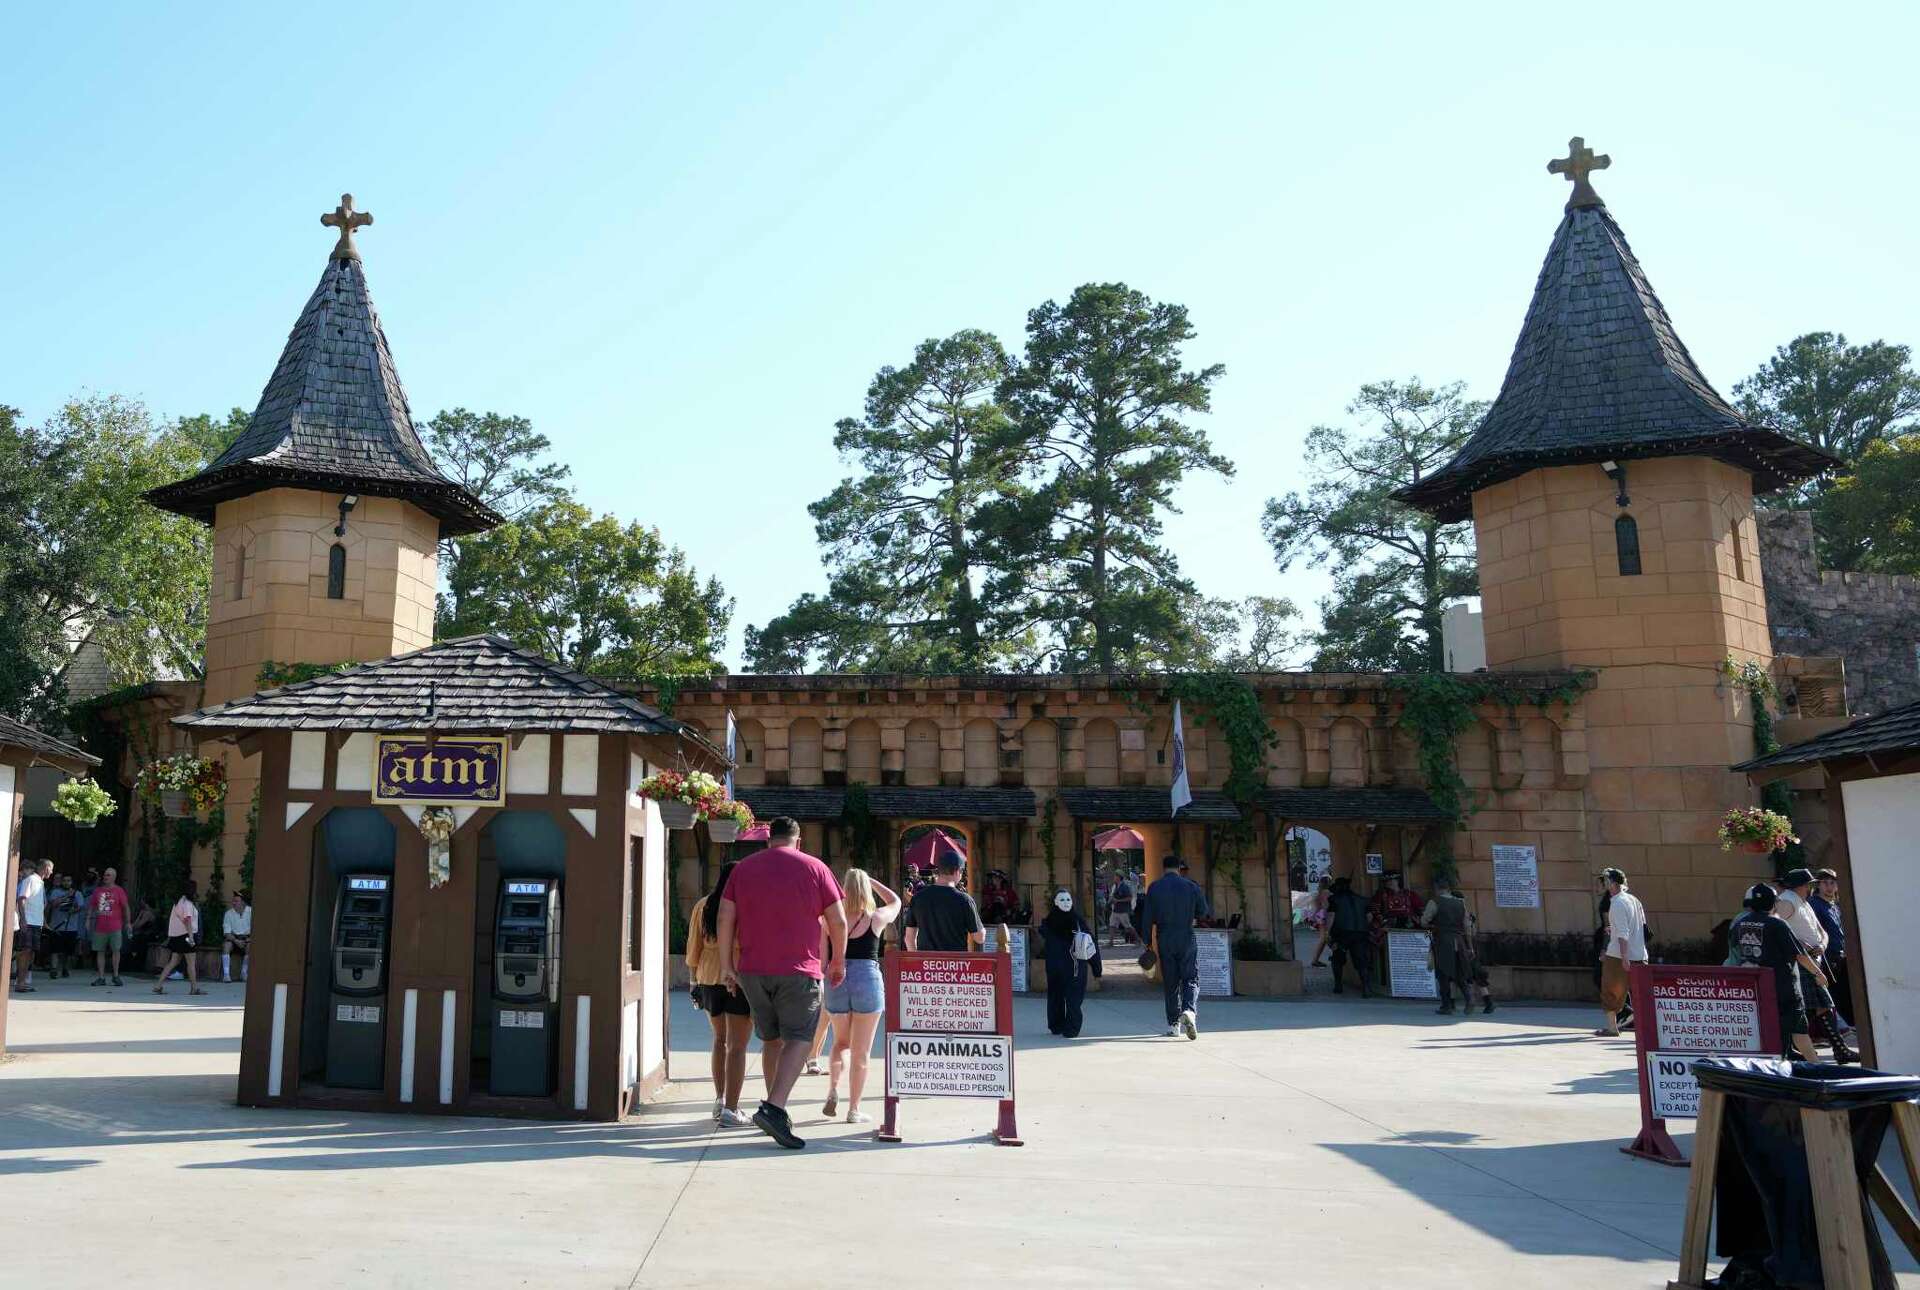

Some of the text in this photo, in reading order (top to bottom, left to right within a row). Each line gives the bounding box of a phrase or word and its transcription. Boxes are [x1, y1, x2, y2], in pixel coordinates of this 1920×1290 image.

[389, 751, 488, 785] atm
[358, 880, 380, 889] ATM
[515, 884, 538, 893] ATM
[923, 961, 970, 970] SECURITY
[901, 972, 993, 983] BAG CHECK AHEAD
[904, 986, 919, 994] ALL
[922, 986, 946, 994] BAGS
[958, 987, 992, 995] PURSES
[1653, 986, 1753, 998] BAG CHECK AHEAD
[932, 998, 942, 1006] BE
[946, 998, 988, 1007] CHECKED
[1657, 1001, 1754, 1012] ALL BAGS & PURSES
[906, 1009, 989, 1018] PLEASE FORM LINE
[1664, 1014, 1749, 1023] WILL BE CHECKED
[958, 1022, 984, 1030] POINT
[1663, 1026, 1752, 1036] PLEASE FORM LINE
[1671, 1038, 1747, 1048] AT CHECK POINT
[898, 1042, 1002, 1057] NO ANIMALS
[946, 1062, 982, 1070] SERVICE
[982, 1063, 1004, 1071] DOGS
[1659, 1061, 1686, 1075] NO
[904, 1072, 996, 1081] SPECIFICALLY TRAINED
[923, 1082, 930, 1090] A
[931, 1082, 970, 1091] DISABLED
[972, 1084, 1004, 1092] PERSON
[1659, 1081, 1692, 1089] EXCEPT
[1669, 1093, 1700, 1101] SPECIF
[1661, 1103, 1672, 1111] TO
